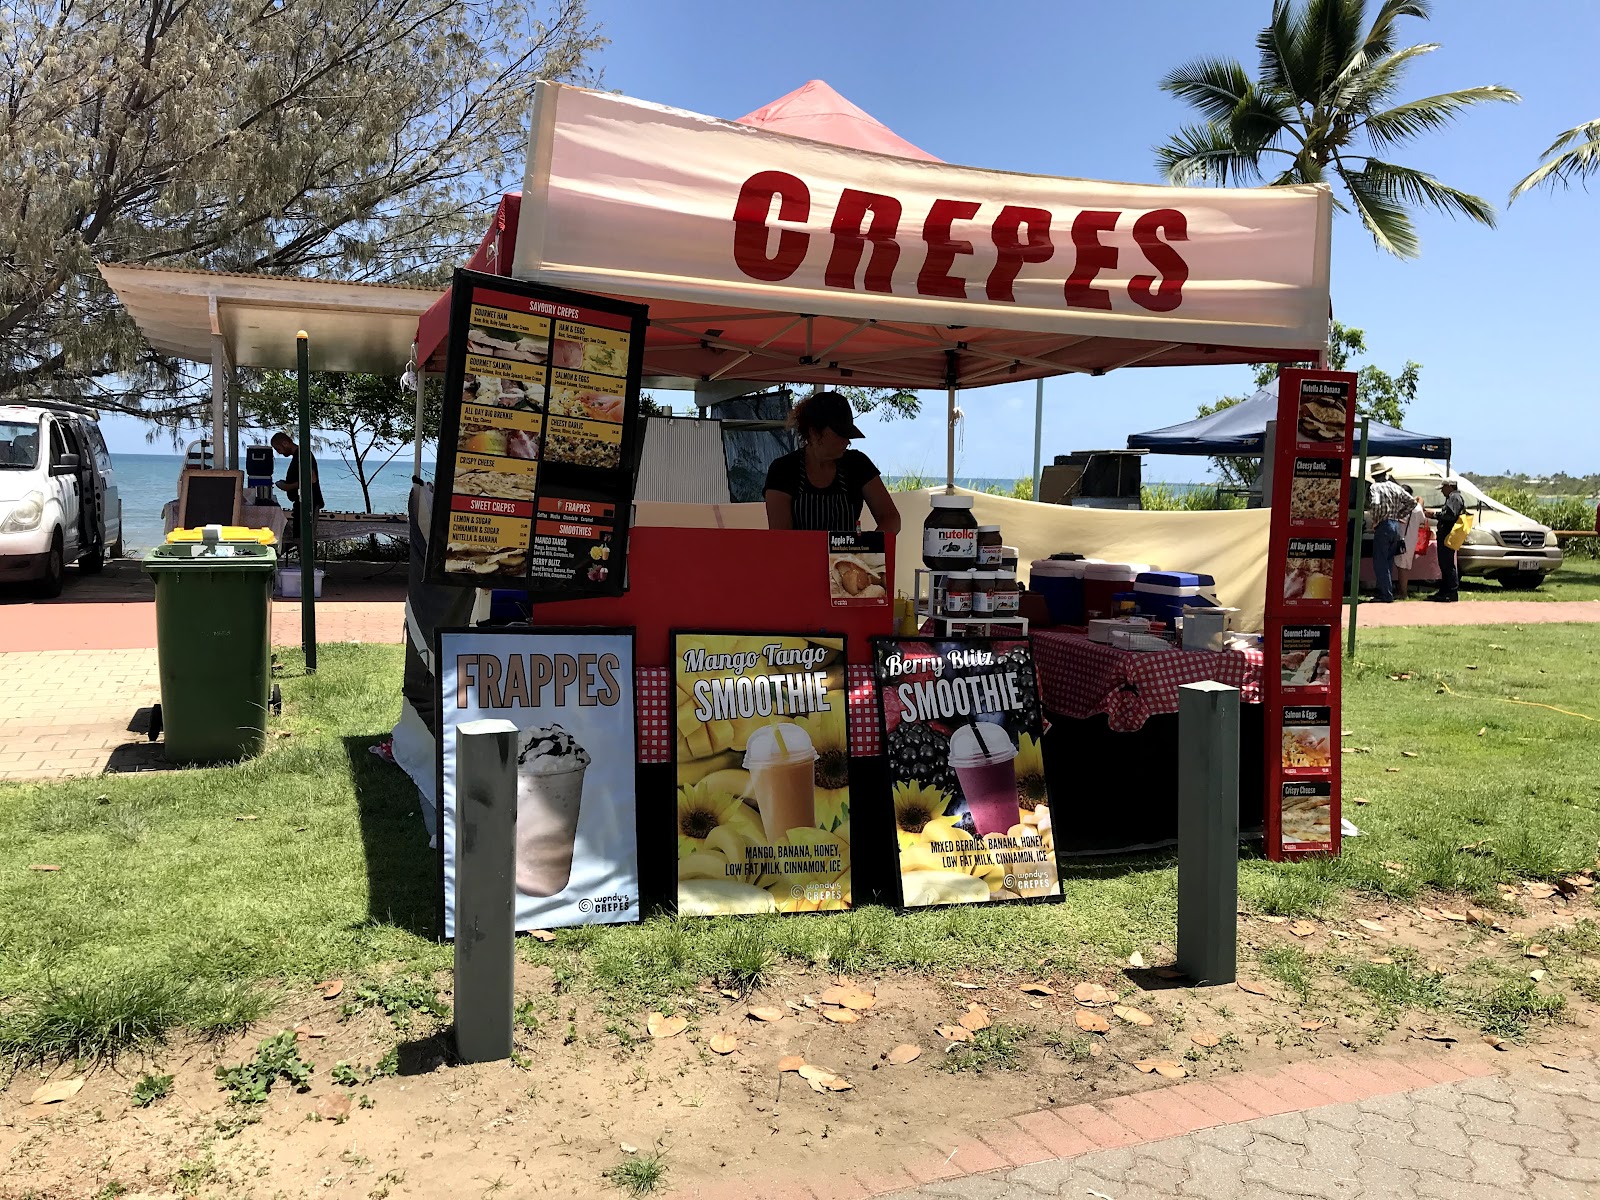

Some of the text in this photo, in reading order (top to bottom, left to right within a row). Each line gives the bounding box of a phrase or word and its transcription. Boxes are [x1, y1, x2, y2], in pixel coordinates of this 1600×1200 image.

[733, 170, 1190, 312] CREPES
[475, 308, 496, 318] GOURMET
[530, 301, 579, 319] SAVOURY CREPES
[575, 325, 585, 334] EGGS
[470, 358, 512, 371] GOURMET SALMON
[555, 372, 573, 380] SALMON
[579, 375, 589, 383] EGGS
[1303, 384, 1340, 394] Nutella & Banana
[494, 410, 513, 420] BREKKIE
[551, 418, 584, 430] CHEESY GARLIC
[460, 456, 494, 467] CRISPY CHEESE
[1297, 461, 1326, 471] Cheesy Garlic
[470, 499, 516, 513] SWEET CREPES
[565, 502, 591, 513] FRAPPES
[454, 515, 470, 523] LEMON
[476, 517, 491, 525] SUGAR
[453, 524, 478, 533] CINNAMON
[484, 527, 499, 535] SUGAR
[559, 525, 592, 536] SMOOTHIES
[939, 529, 973, 539] nutella
[452, 533, 472, 541] NUTELLA
[478, 535, 498, 543] BANANA
[535, 536, 552, 545] MANGO
[552, 538, 567, 546] TANGO
[831, 536, 854, 546] Apple Pie
[1298, 542, 1306, 552] Day
[1284, 629, 1303, 637] Gourmet
[683, 643, 828, 675] Mango Tango
[886, 649, 994, 677] Berry Blitz
[457, 653, 620, 708] FRAPPES
[694, 671, 831, 722] SMOOTHIE
[898, 672, 1023, 722] SMOOTHIE
[1306, 710, 1317, 720] Eggs
[1285, 786, 1299, 795] Crispy
[931, 836, 1046, 853] MIXED BERRIES, BANANA, HONEY,
[746, 844, 840, 860] MANGO, BANANA, HONEY,
[942, 850, 1047, 868] LOW FAT MILK, CINNAMON, ICE
[726, 860, 841, 876] LOW FAT MILK, CINNAMON, ICE
[1018, 870, 1048, 880] wendy's
[807, 882, 841, 890] wendy's
[1018, 880, 1050, 890] CREPES
[594, 893, 629, 903] wendy's
[807, 890, 841, 901] CREPES
[595, 902, 629, 913] CREPES
